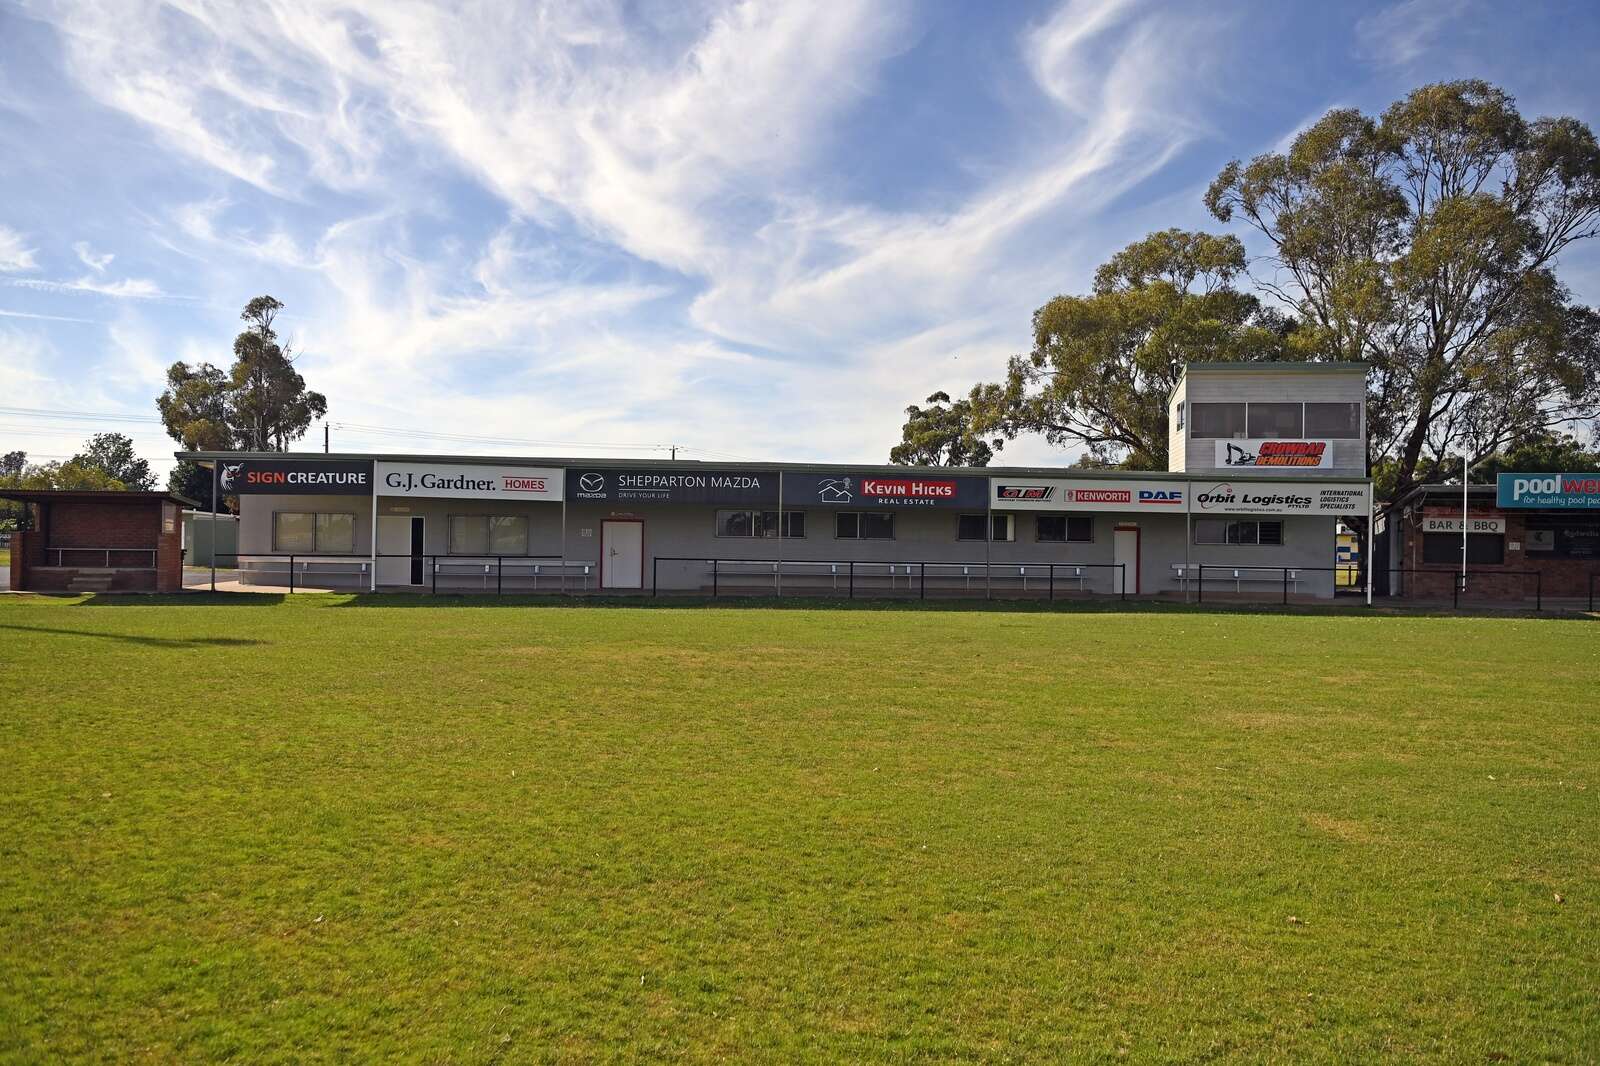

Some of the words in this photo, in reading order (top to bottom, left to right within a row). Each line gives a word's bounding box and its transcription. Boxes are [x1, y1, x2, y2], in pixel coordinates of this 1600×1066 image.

[1259, 442, 1326, 455] CROWBAR
[1255, 456, 1322, 466] DEMOLITIONS
[505, 479, 545, 490] HOMES
[618, 475, 706, 488] SHEPPARTON
[711, 476, 760, 489] MAZDA
[1077, 491, 1130, 502] KENWORTH
[1138, 490, 1182, 500] DAF
[1198, 493, 1236, 503] Orbit
[1241, 494, 1312, 506] Logistics
[1523, 495, 1535, 504] for
[1537, 496, 1566, 506] healthy
[1568, 495, 1585, 506] pool
[1429, 521, 1453, 530] BAR
[1474, 521, 1499, 532] BBQ
